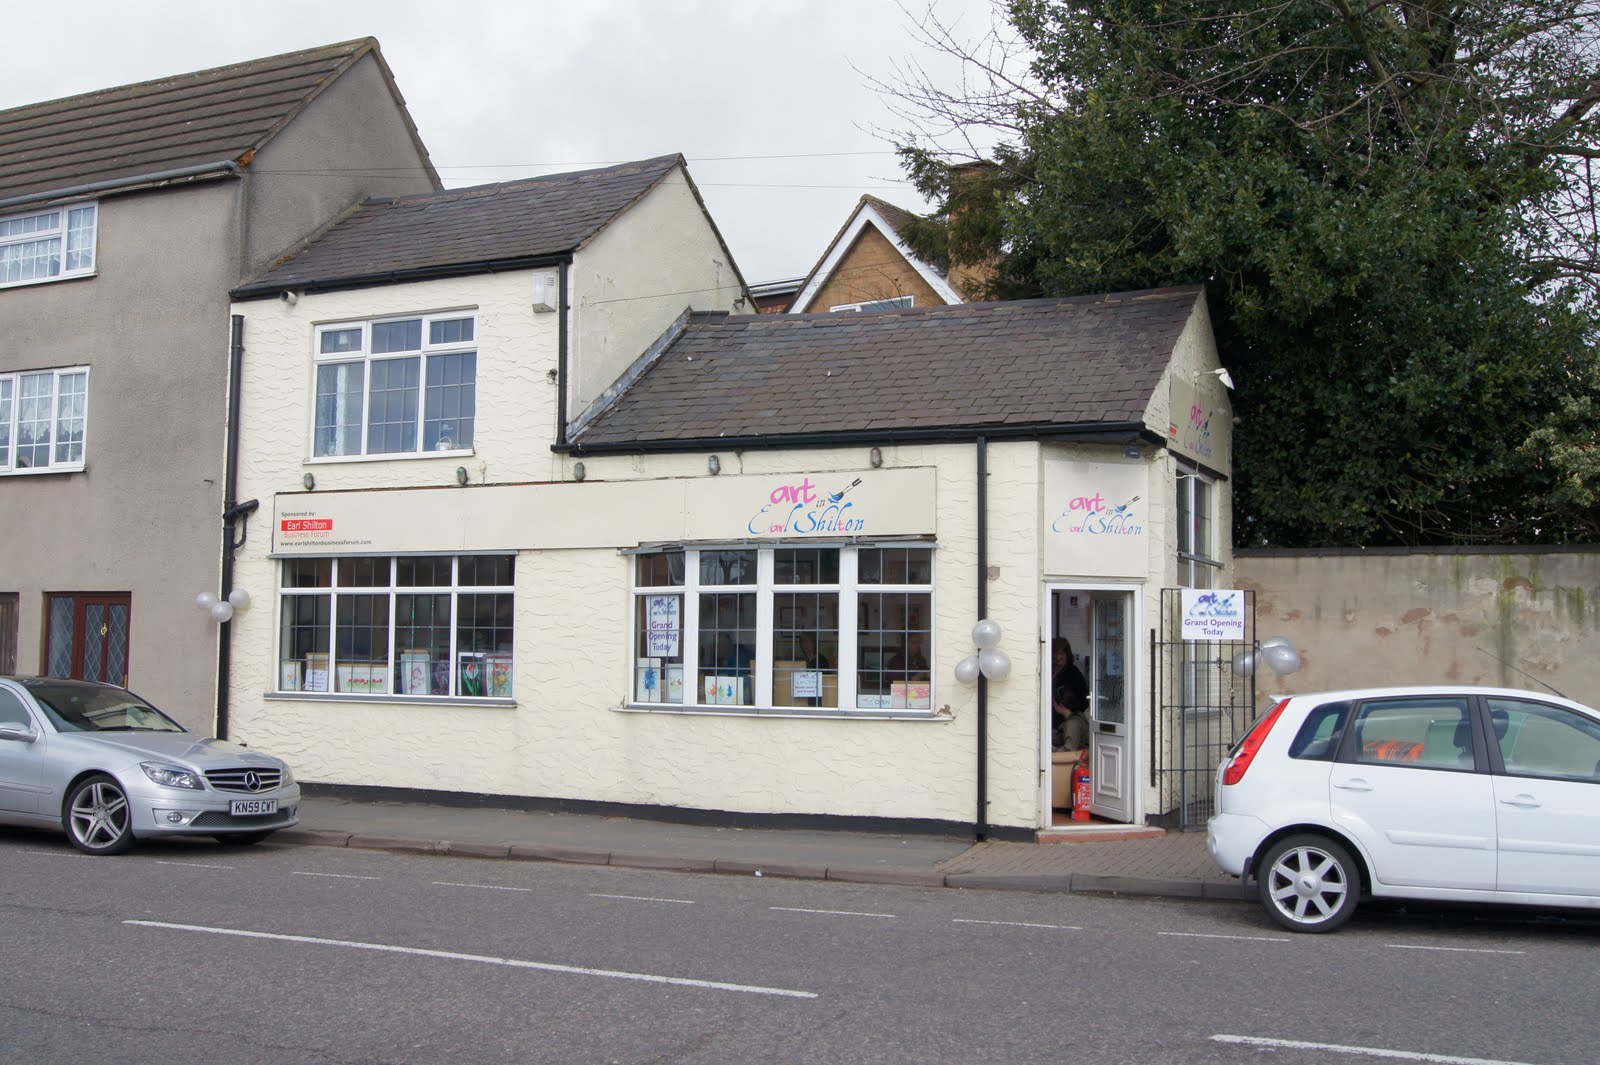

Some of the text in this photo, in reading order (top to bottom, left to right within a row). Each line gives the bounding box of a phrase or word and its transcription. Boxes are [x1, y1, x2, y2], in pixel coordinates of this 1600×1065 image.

[769, 478, 817, 504] art
[816, 498, 826, 508] in
[1069, 492, 1106, 513] art
[748, 502, 864, 534] Earl Shilton
[1052, 510, 1142, 535] Earl Shilton
[287, 520, 327, 530] Earl Shilton
[284, 530, 330, 539] Business Forum
[280, 539, 372, 547] www.earlshiltonbusinessforum.com
[1198, 592, 1218, 604] art
[651, 621, 673, 629] Grand
[1184, 618, 1242, 628] Grand Opening
[648, 632, 677, 642] Opening
[1202, 628, 1224, 637] Today
[652, 643, 672, 653] Today
[235, 801, 260, 813] KN59
